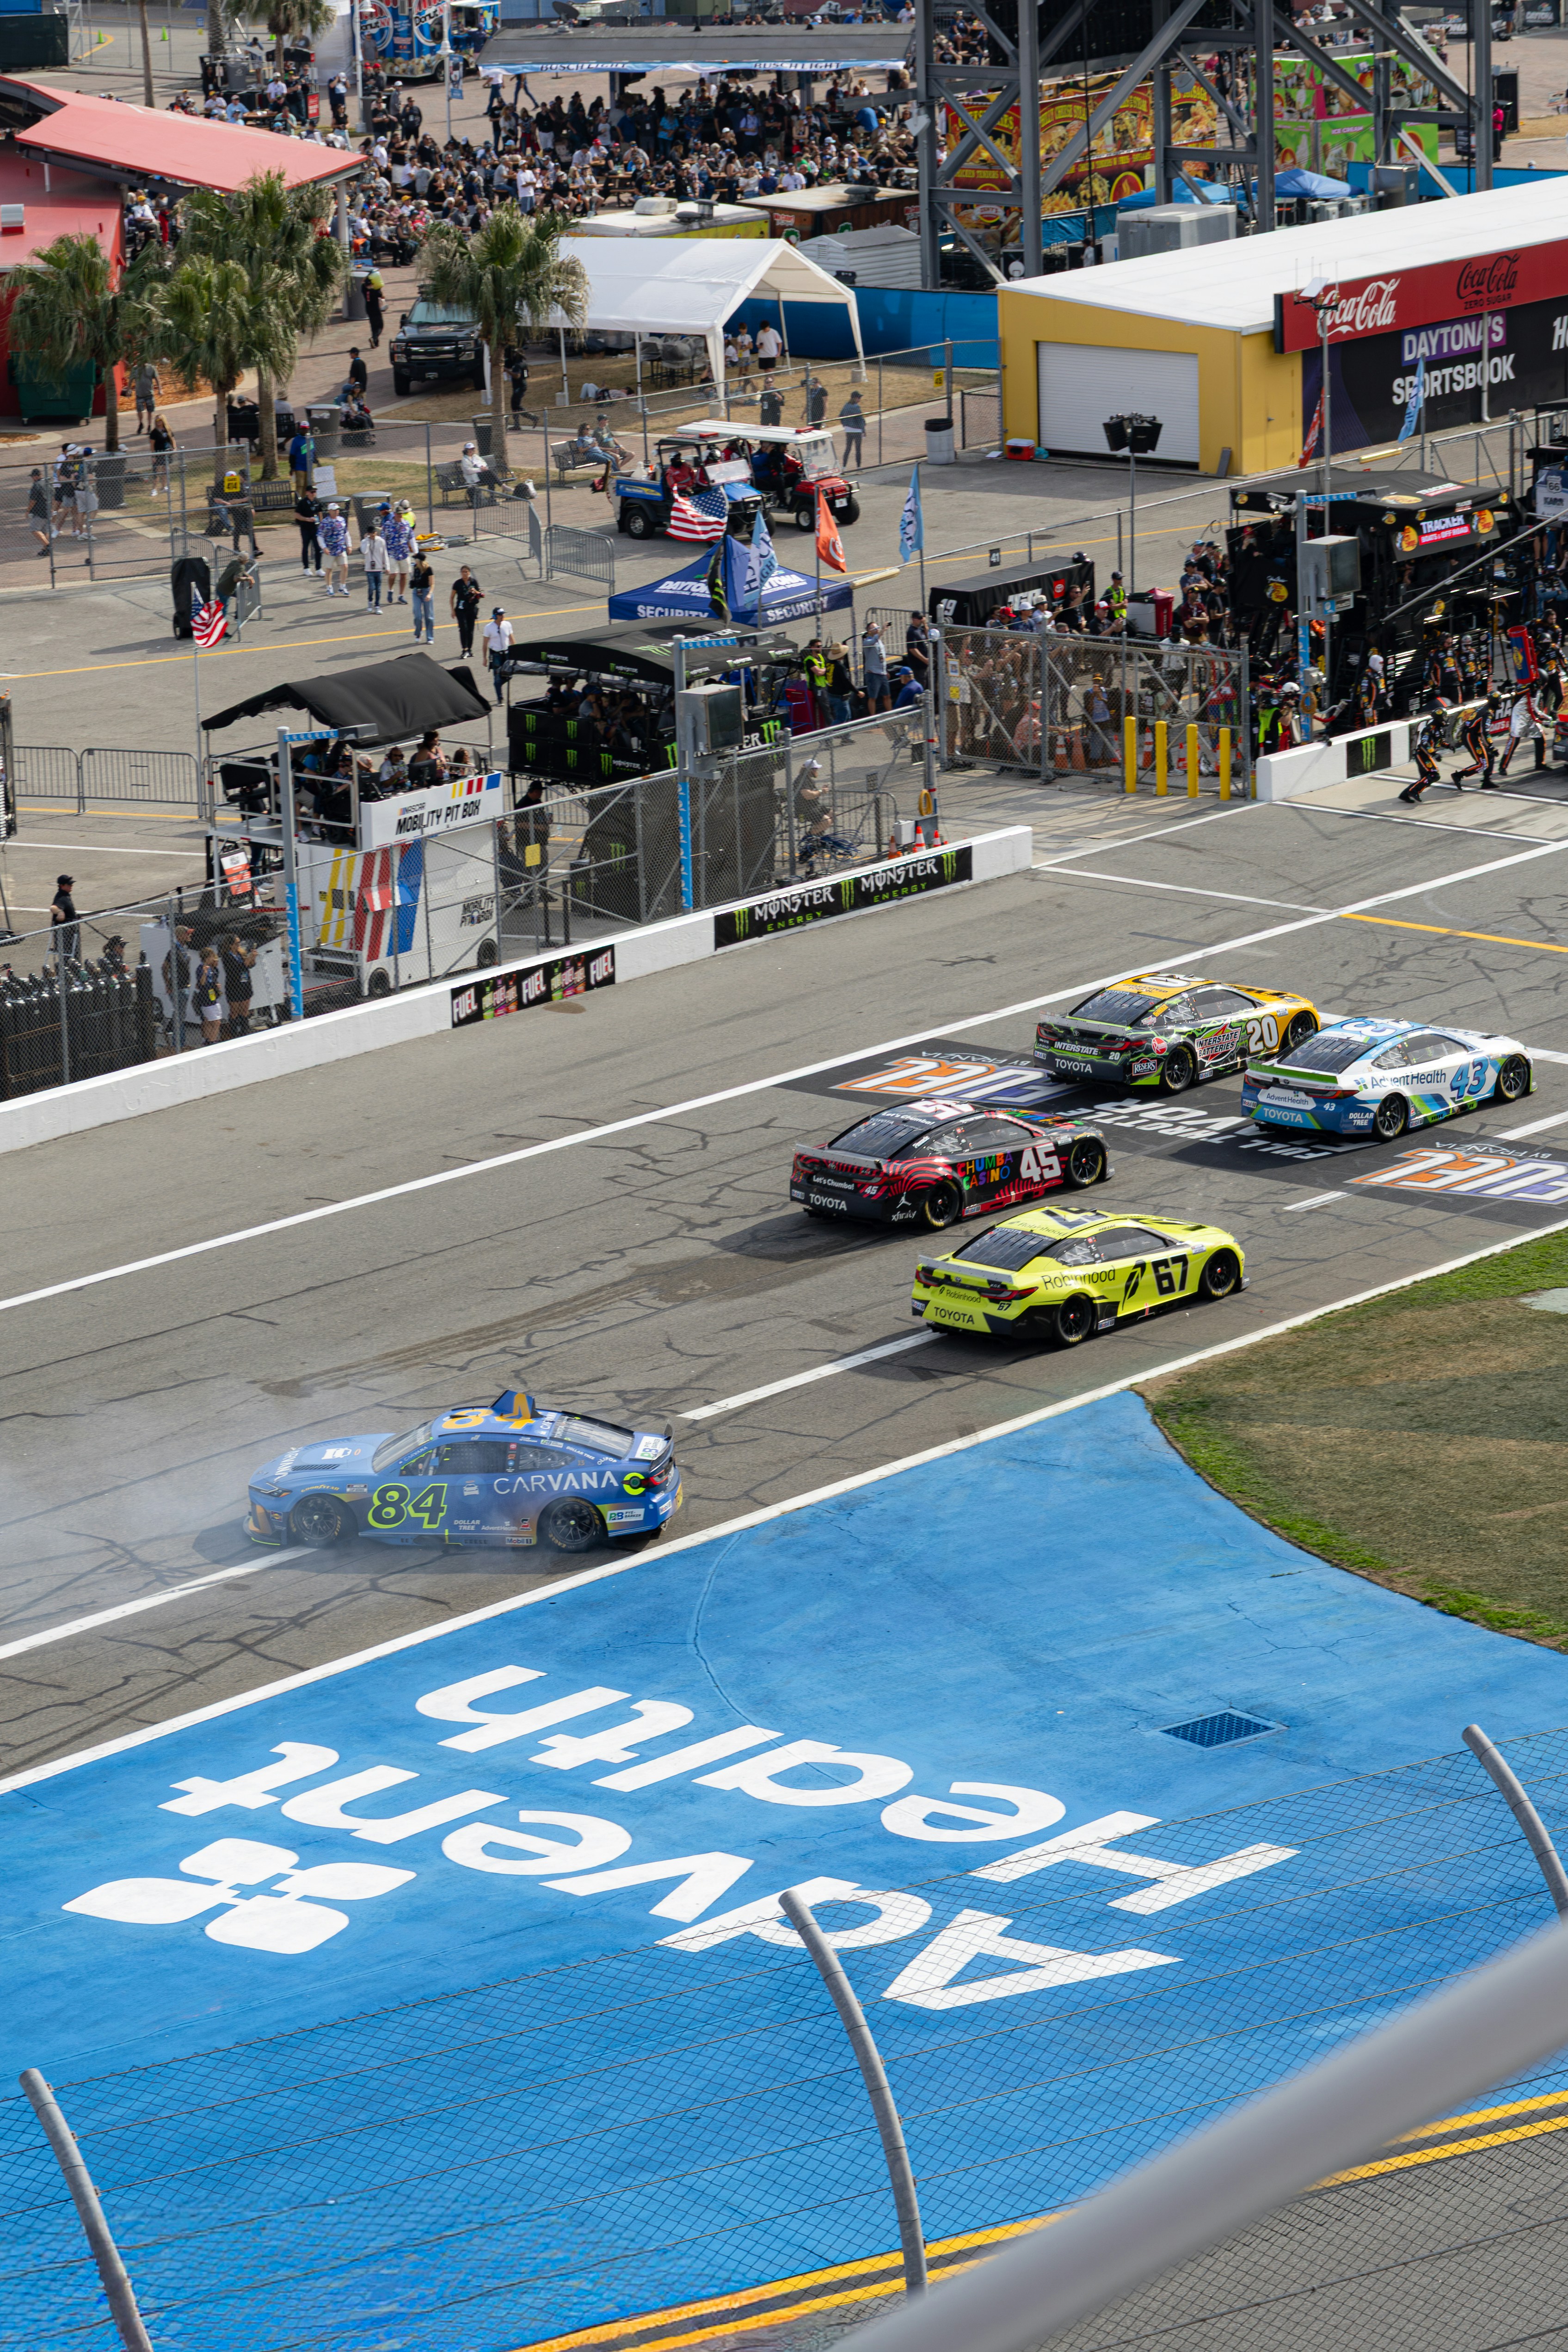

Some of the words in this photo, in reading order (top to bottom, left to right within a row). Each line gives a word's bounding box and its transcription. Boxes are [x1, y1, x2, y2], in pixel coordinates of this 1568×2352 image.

[1341, 126, 1363, 134] CREAM
[1456, 253, 1522, 300] Coca-Cola
[1317, 277, 1401, 338] Coca-Cola
[1464, 298, 1484, 310] ZERO
[1486, 293, 1512, 306] SUGAR
[1403, 315, 1504, 362] DAYTONA'S
[1549, 482, 1560, 491] 66
[1420, 514, 1465, 534] TRACKER
[1421, 534, 1438, 543] BOATS
[1454, 526, 1470, 535] ROAD
[990, 551, 1000, 562] 41
[637, 604, 709, 618] SECURITY
[766, 596, 828, 622] SECURITY
[612, 758, 641, 770] MONSTER
[405, 802, 426, 814] NASCAR
[395, 808, 443, 835] MOBILITY
[445, 804, 461, 823] PIT
[461, 799, 481, 819] BOX
[861, 858, 939, 893] MONSTER
[873, 882, 927, 903] ENERGY
[754, 886, 836, 922] MONSTER
[767, 910, 823, 932] ENERGY
[589, 949, 615, 986] FUEL
[521, 967, 547, 1005] FUEL
[452, 986, 478, 1024] FUEL
[1196, 1031, 1239, 1048] INTERSTATE
[1245, 1014, 1279, 1054] 20
[1054, 1041, 1100, 1056] INTERSTATE
[1109, 1052, 1120, 1060] 20
[1199, 1040, 1235, 1057] BATTERIES
[921, 1051, 1008, 1064] FRANZIA
[1055, 1058, 1093, 1073] TOYOTA
[1134, 1062, 1156, 1073] RESER'S
[1371, 1069, 1446, 1089] AdventHealth
[1449, 1056, 1489, 1101] 43
[1266, 1093, 1309, 1106] AdventHealth
[1323, 1102, 1336, 1111] 43
[900, 1114, 935, 1126] Chumba!
[1263, 1108, 1304, 1123] TOYOTA
[1056, 1108, 1237, 1144] THROTTLE
[1238, 1139, 1334, 1160] FULL
[1435, 1141, 1526, 1157] FRANZIA
[957, 1150, 1014, 1177] CHUMBA
[1020, 1142, 1062, 1182] 45
[812, 1175, 826, 1185] Let's
[827, 1178, 855, 1190] Chumba!
[962, 1165, 1010, 1191] CASINO
[864, 1185, 879, 1195] 45
[809, 1194, 848, 1211] TOYOTA
[891, 1210, 917, 1222] xfinity
[1018, 1222, 1069, 1237] Robinhood
[1041, 1265, 1116, 1291] Robinhood
[1150, 1252, 1190, 1296] 67
[946, 1289, 981, 1304] Robinhood
[996, 1302, 1012, 1311] 67
[934, 1306, 975, 1325] TOYOTA
[566, 1446, 583, 1456] DOLLAR
[597, 1457, 617, 1466] OLIPOP
[301, 1484, 340, 1493] GOODYEAR
[493, 1471, 619, 1495] CARVANA
[367, 1483, 448, 1529] 84
[415, 1663, 1299, 1914] Health
[159, 1741, 1182, 2012] Advent
